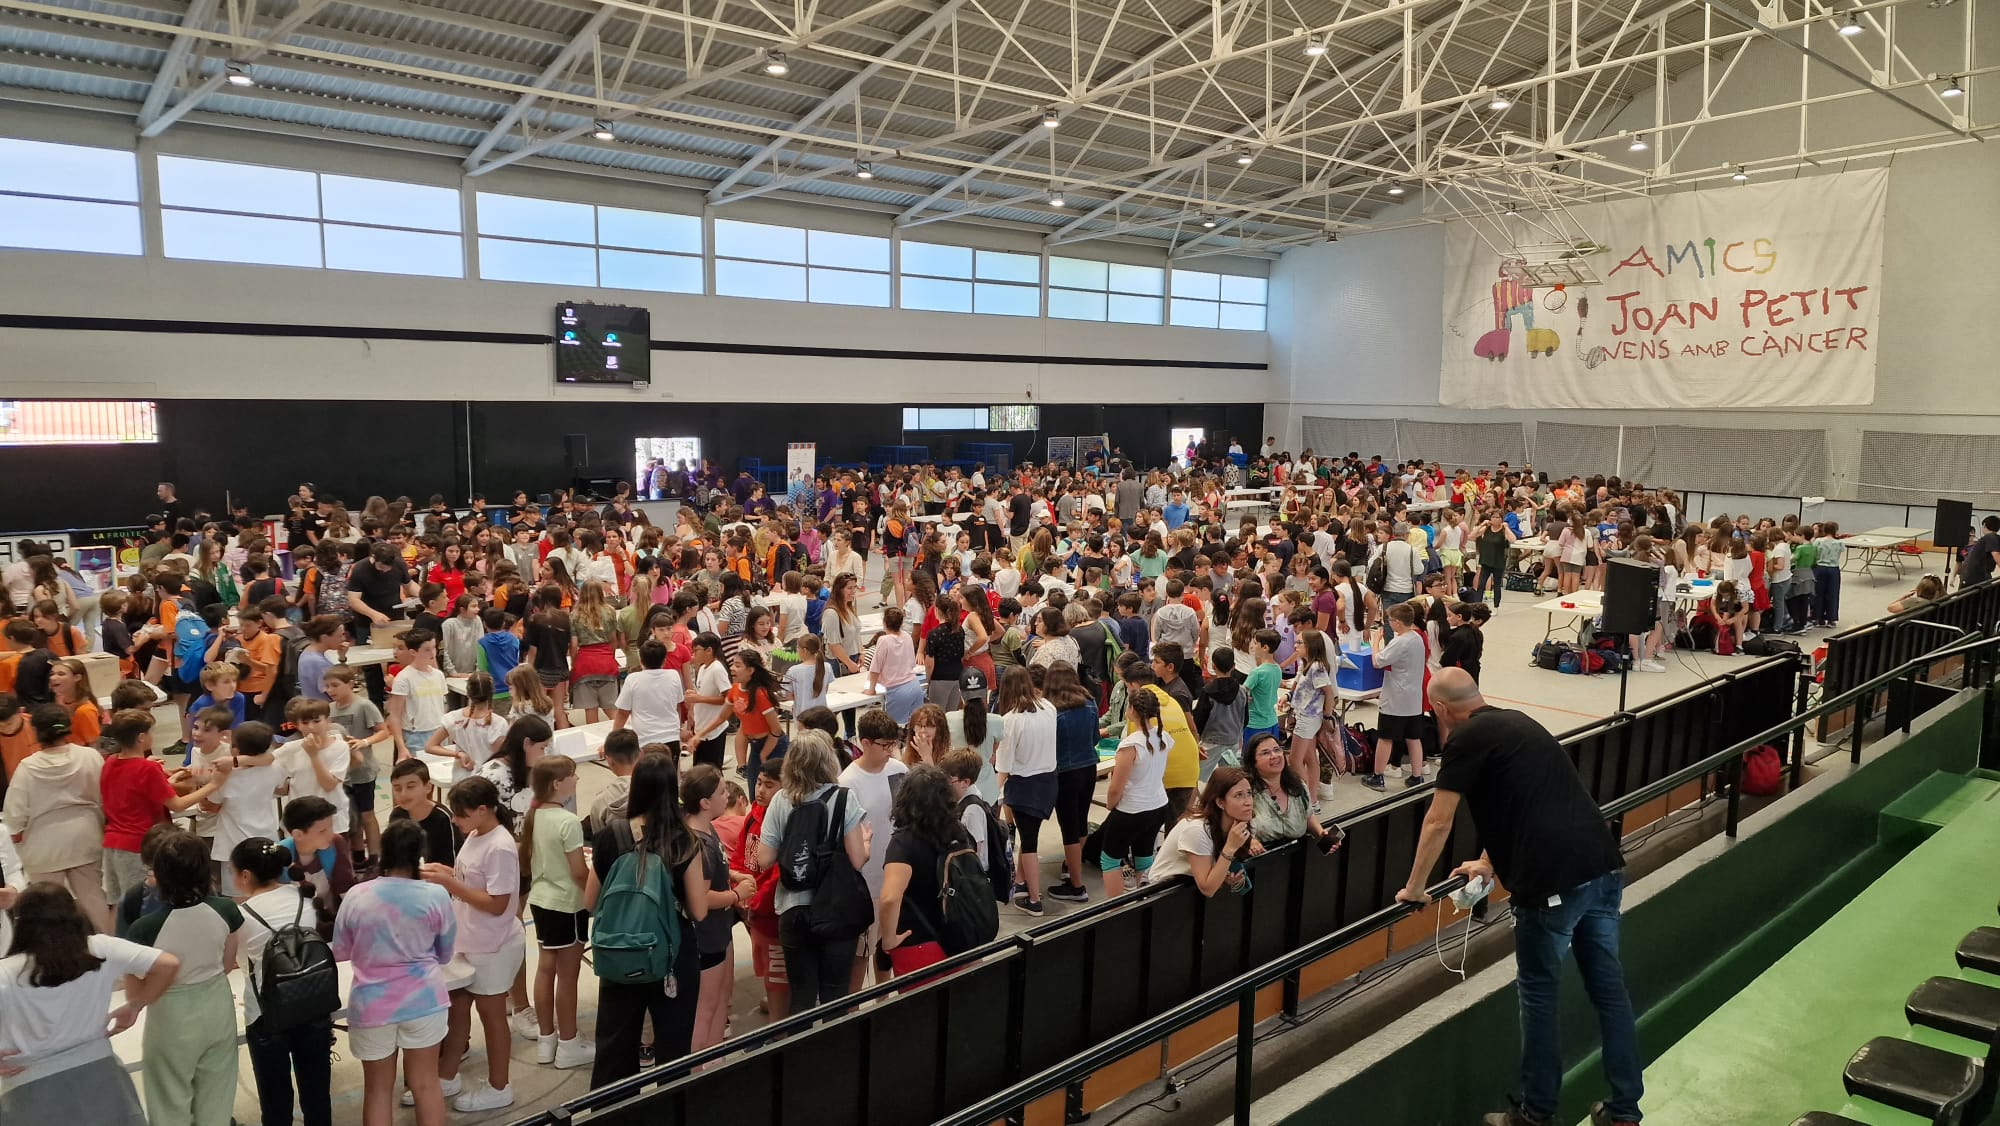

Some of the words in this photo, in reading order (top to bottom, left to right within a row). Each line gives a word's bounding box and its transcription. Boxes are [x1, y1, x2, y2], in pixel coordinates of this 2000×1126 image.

[1606, 291, 1718, 336] JOAN
[1739, 286, 1868, 328] PETIT
[1601, 339, 1670, 361] NENS
[1680, 339, 1730, 358] AMB
[1740, 328, 1868, 358] CÀNCER
[92, 532, 105, 540] LA
